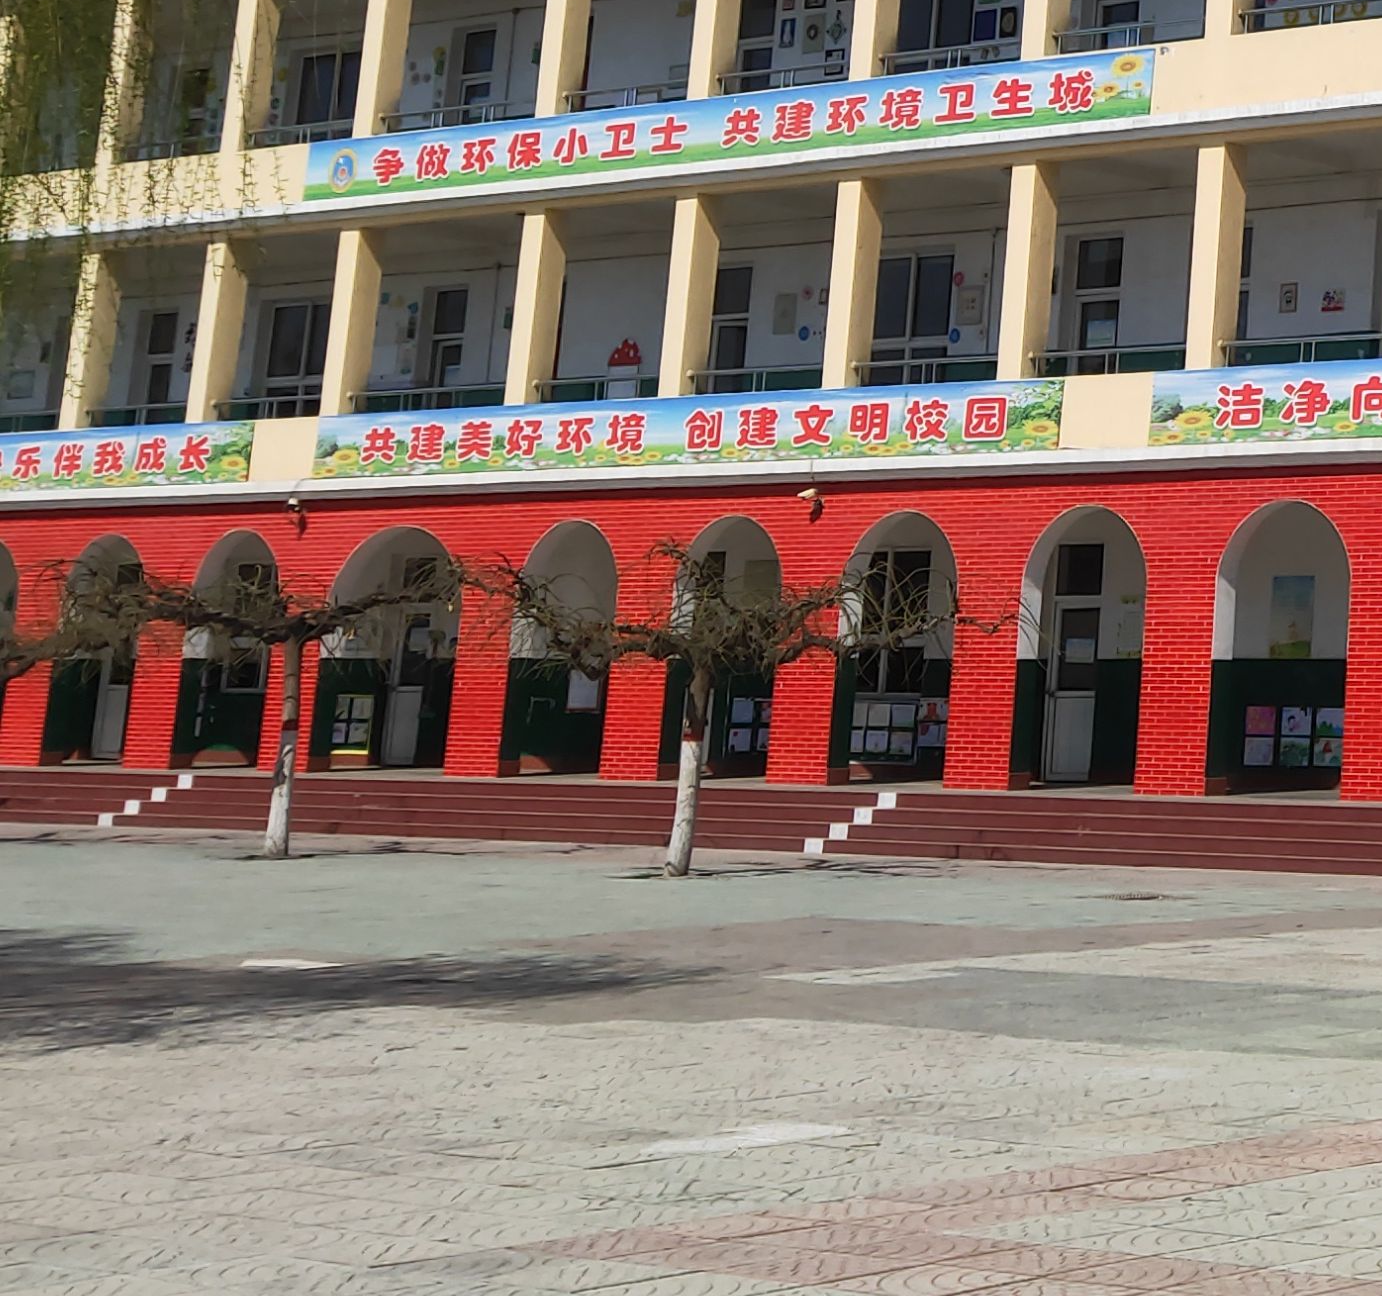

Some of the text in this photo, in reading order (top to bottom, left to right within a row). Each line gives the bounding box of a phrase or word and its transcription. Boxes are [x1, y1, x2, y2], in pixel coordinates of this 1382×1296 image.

[371, 69, 1098, 186] 争做环保小卫士 共建环境卫生城
[0, 436, 211, 481] 乐伴我成长
[360, 395, 1009, 465] 共建美好环境 创建文明校园
